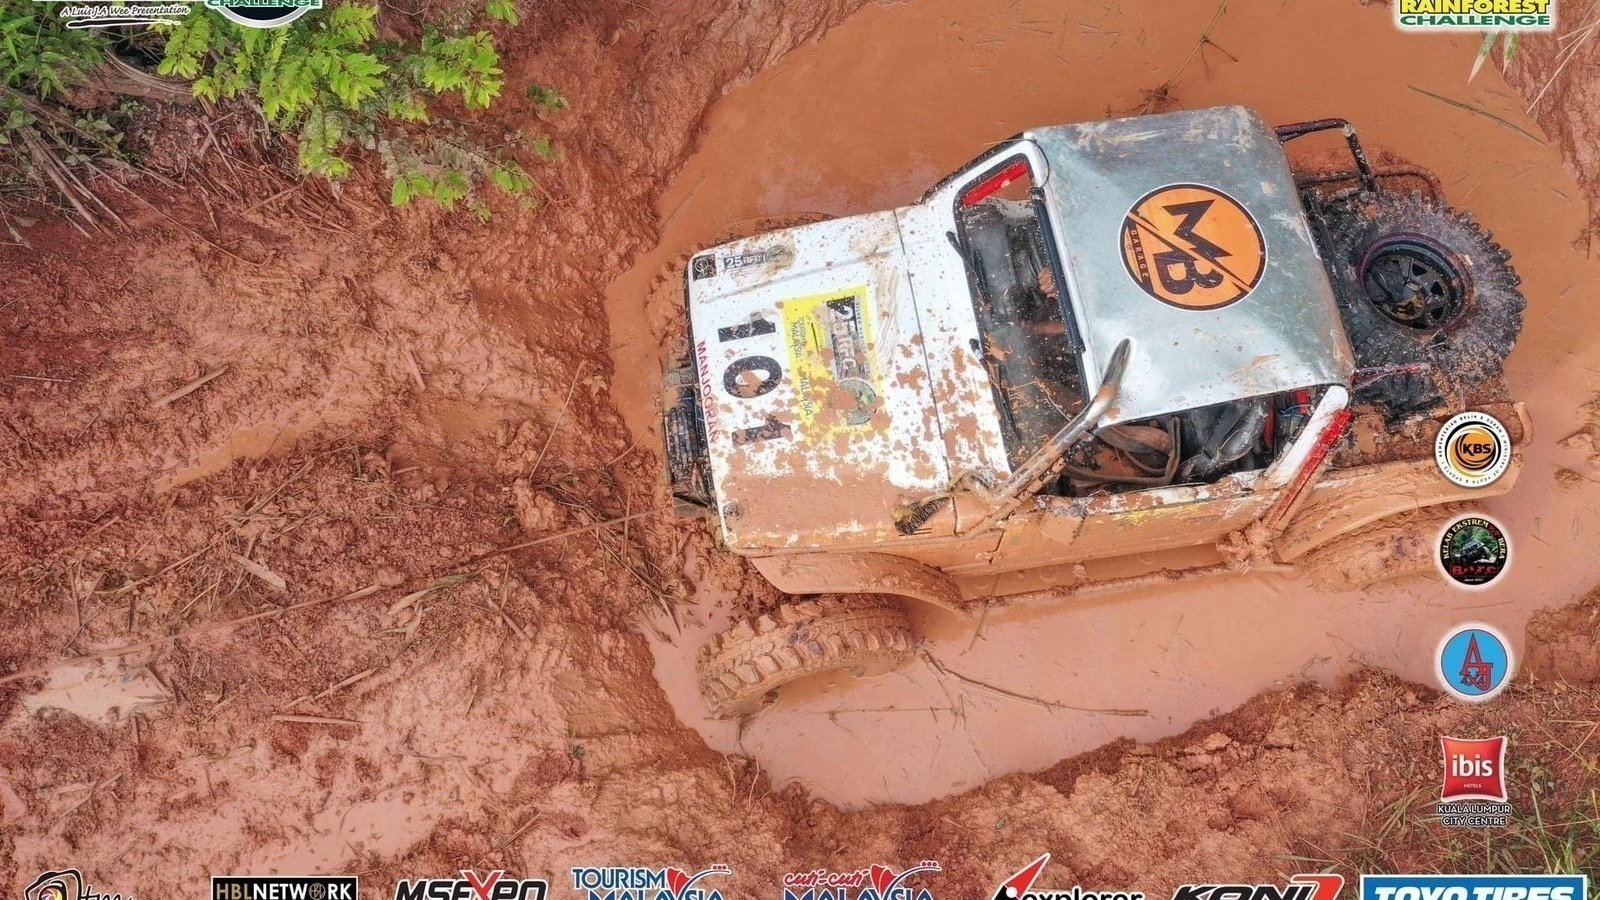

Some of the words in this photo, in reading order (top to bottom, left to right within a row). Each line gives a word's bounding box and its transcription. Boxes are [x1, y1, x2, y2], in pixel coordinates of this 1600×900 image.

[1130, 229, 1150, 278] GARAGE
[696, 341, 719, 443] MANJOORAN
[799, 373, 814, 416] ALAYSIA
